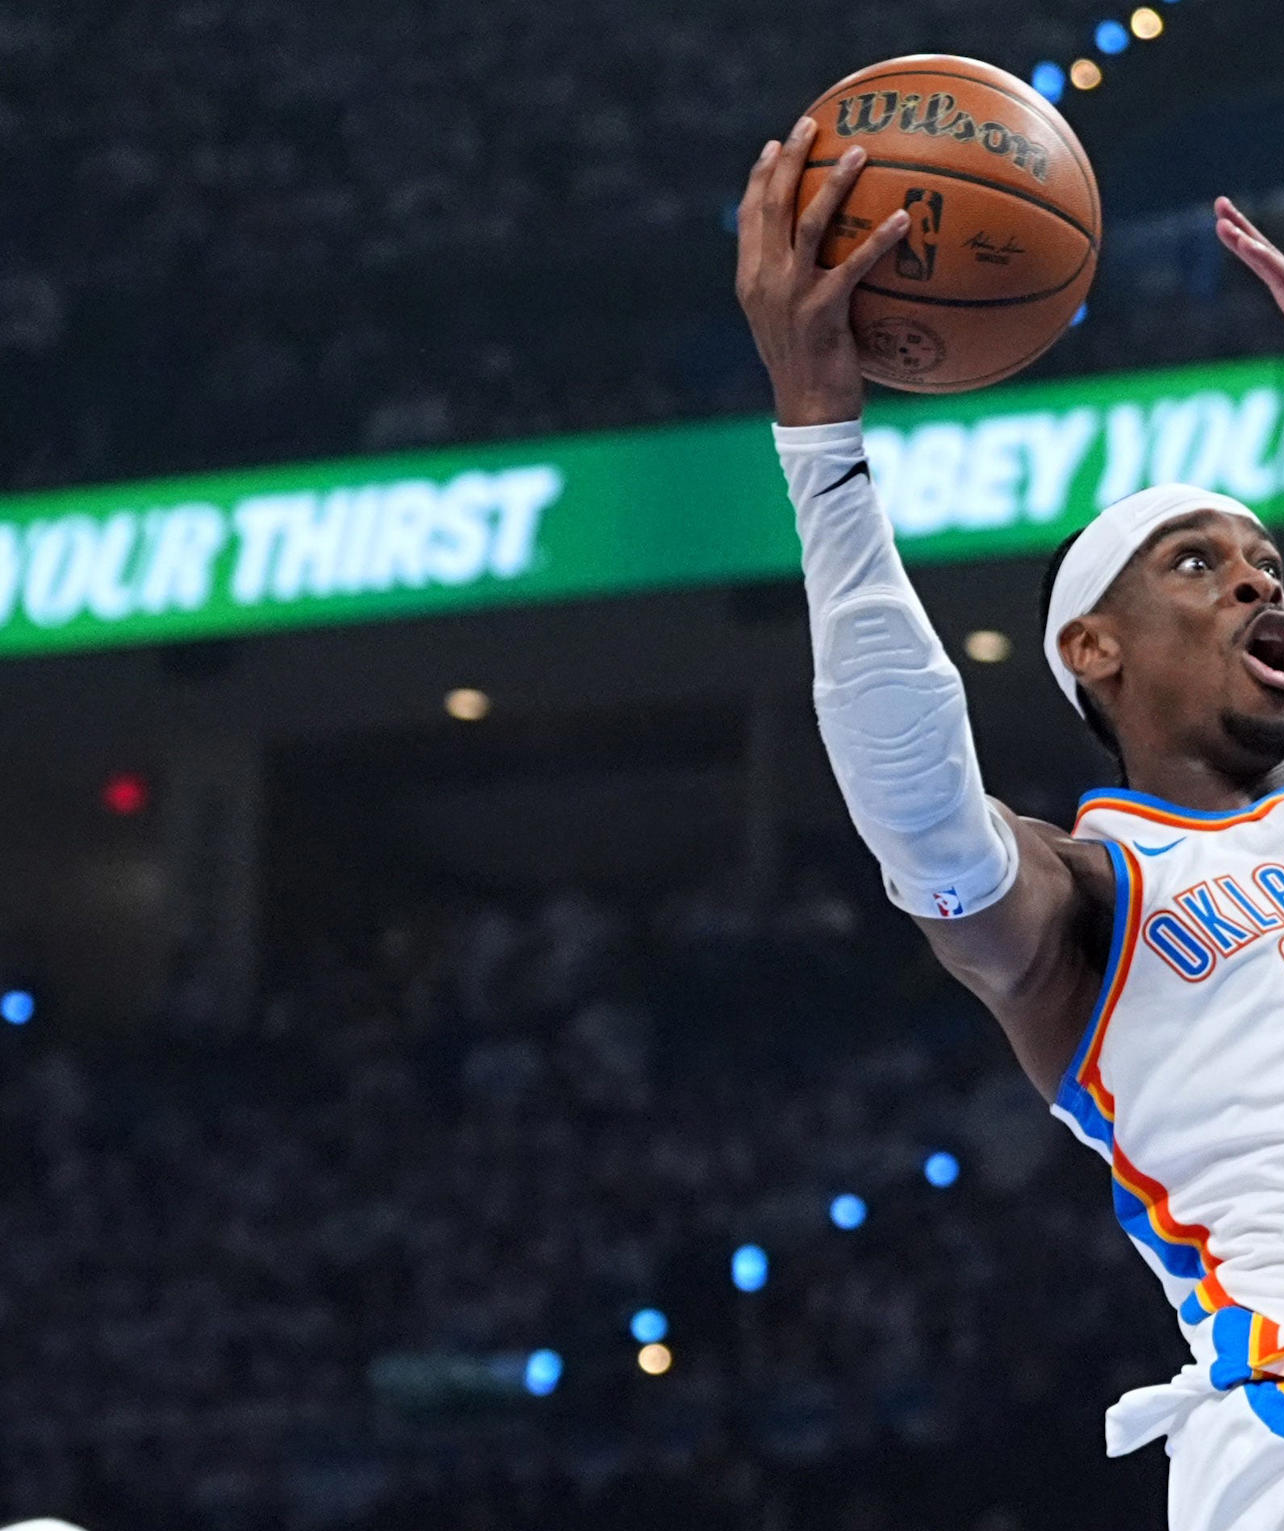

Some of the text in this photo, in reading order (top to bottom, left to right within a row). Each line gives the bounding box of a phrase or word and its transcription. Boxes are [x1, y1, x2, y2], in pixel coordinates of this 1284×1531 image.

[835, 89, 1050, 185] Wilson
[0, 463, 566, 628] OUR THIRST
